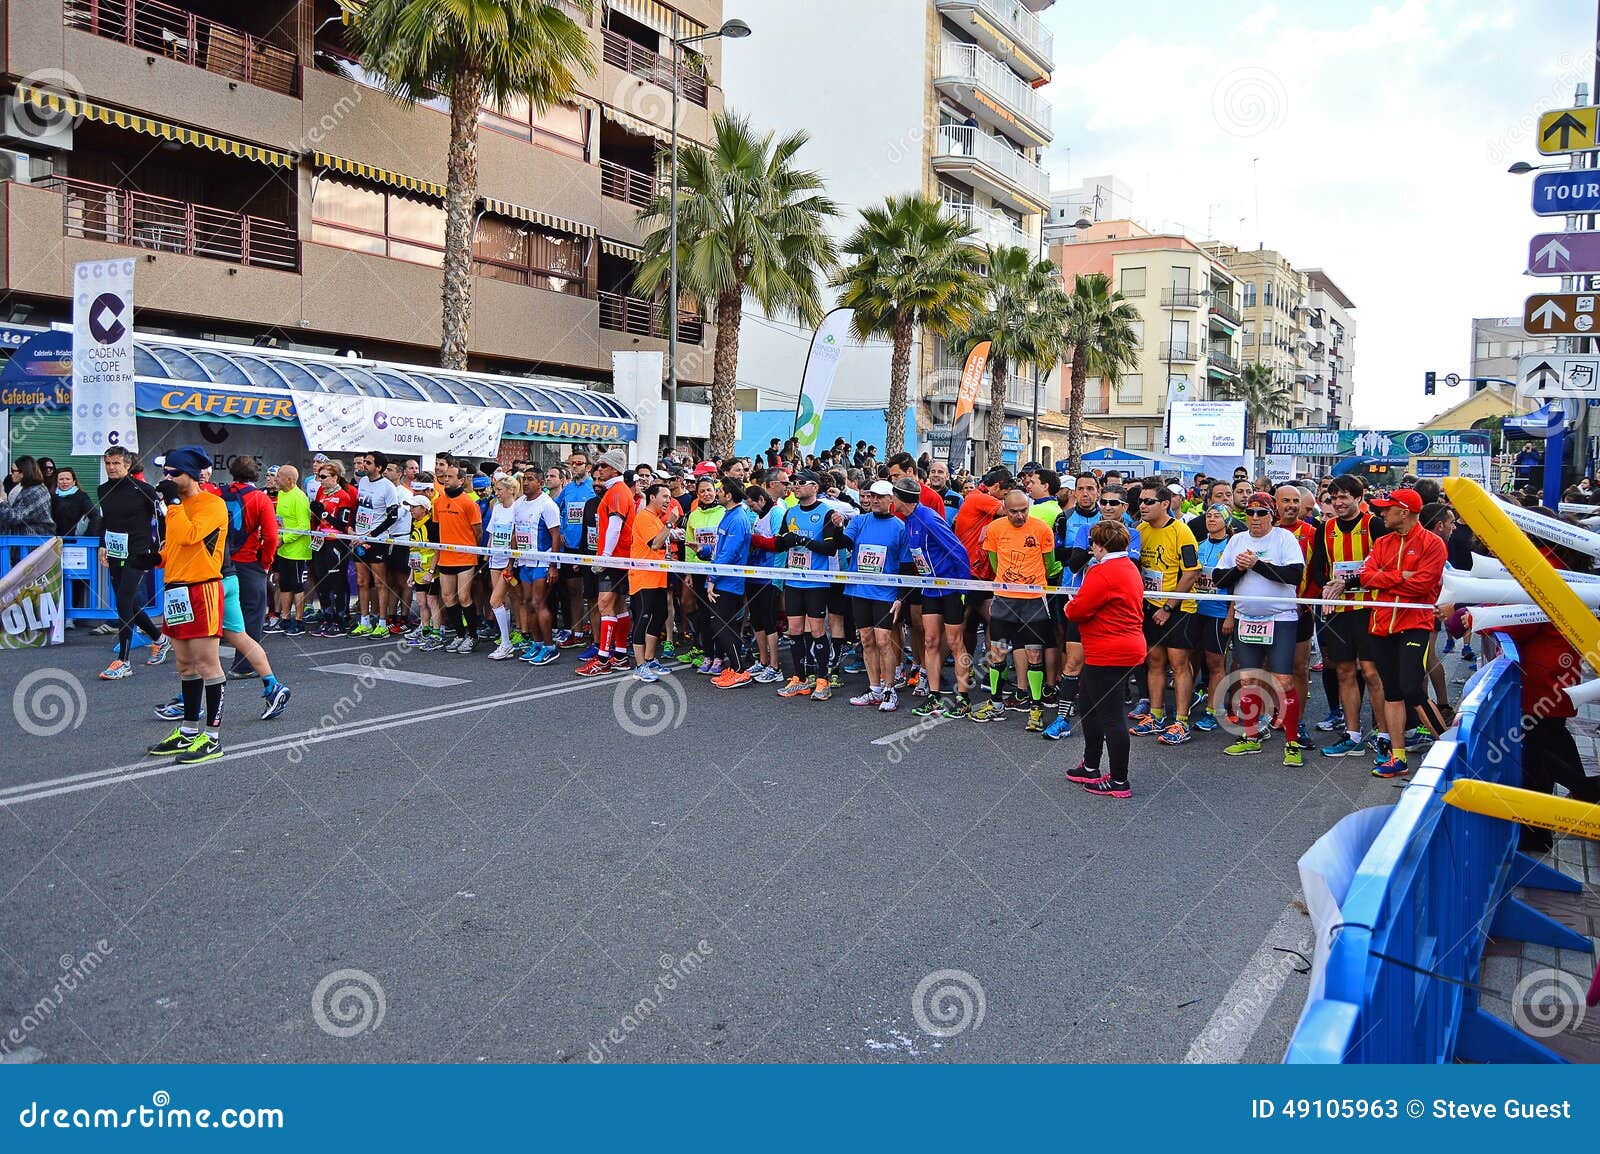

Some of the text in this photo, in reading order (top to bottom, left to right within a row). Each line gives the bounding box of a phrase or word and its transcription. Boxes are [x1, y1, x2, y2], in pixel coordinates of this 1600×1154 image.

[1544, 184, 1600, 200] TOUR
[88, 347, 127, 359] CADENA
[94, 361, 120, 373] COPE
[83, 375, 101, 383] ELCHE
[103, 374, 121, 382] 100.8
[2, 387, 45, 405] Cafetería
[162, 391, 300, 418] CAFETER
[390, 416, 444, 430] COPE ELCHE
[394, 434, 424, 443] 100.8 FM
[862, 555, 881, 564] 6727
[167, 602, 188, 615] 3788
[1246, 624, 1268, 634] 7921
